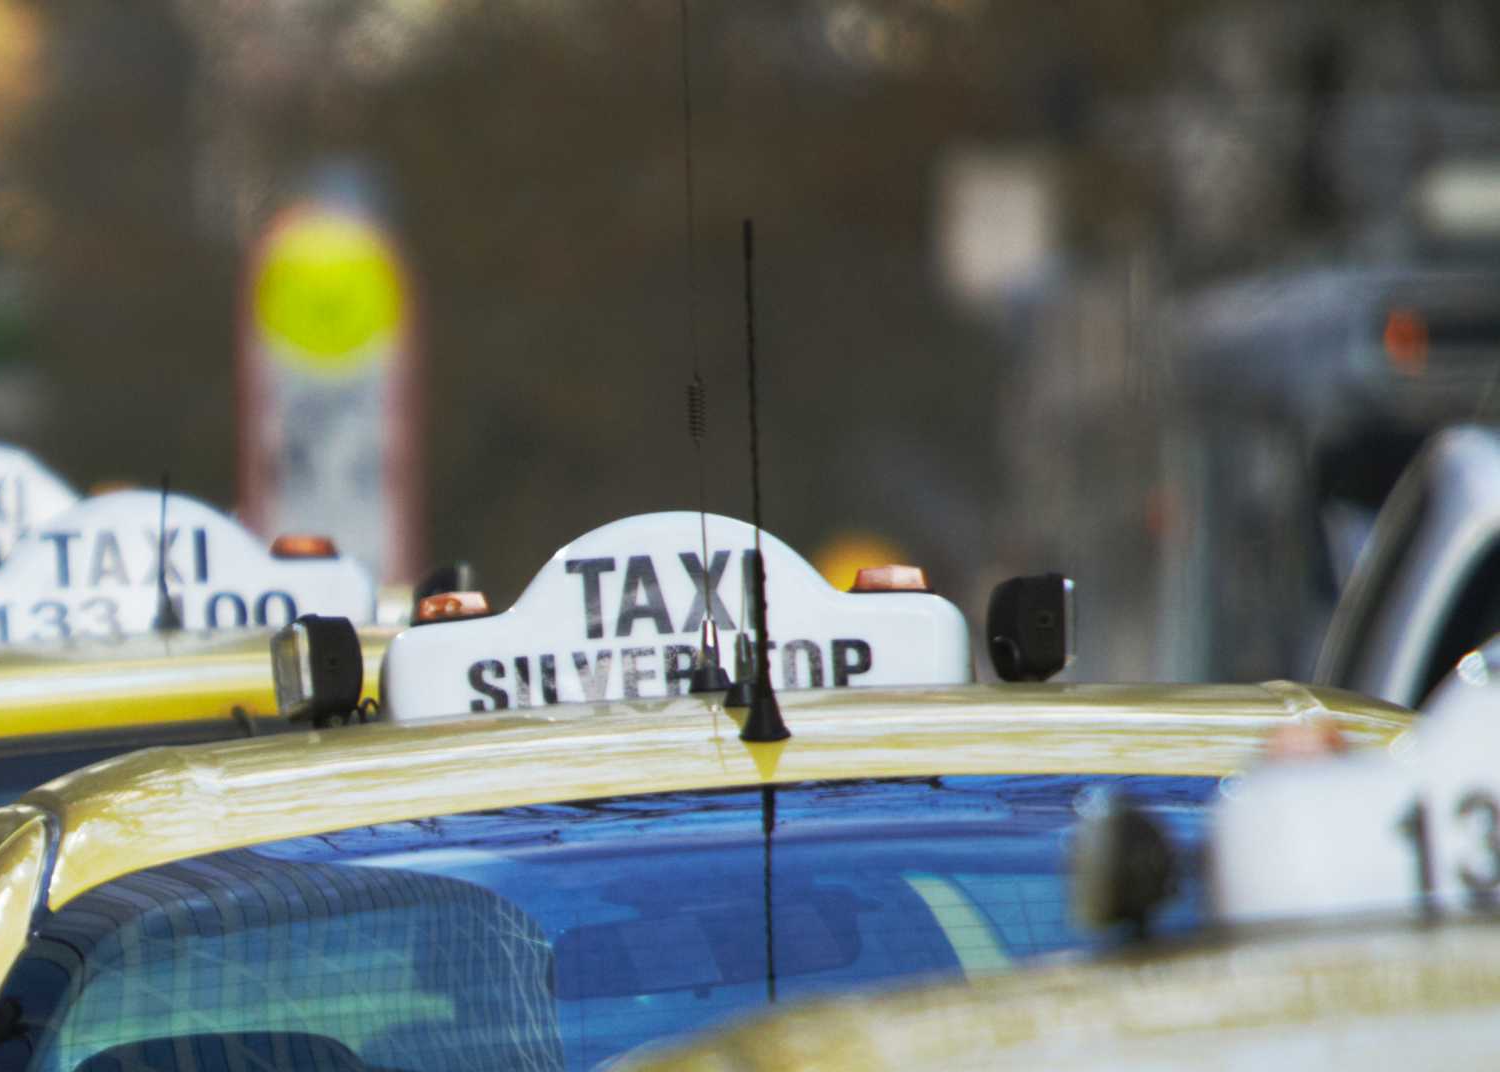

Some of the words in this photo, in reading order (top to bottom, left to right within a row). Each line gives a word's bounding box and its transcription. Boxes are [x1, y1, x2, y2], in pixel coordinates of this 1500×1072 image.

[40, 527, 209, 588] TAXI
[565, 548, 764, 640] TAXI
[467, 641, 710, 712] SILVER
